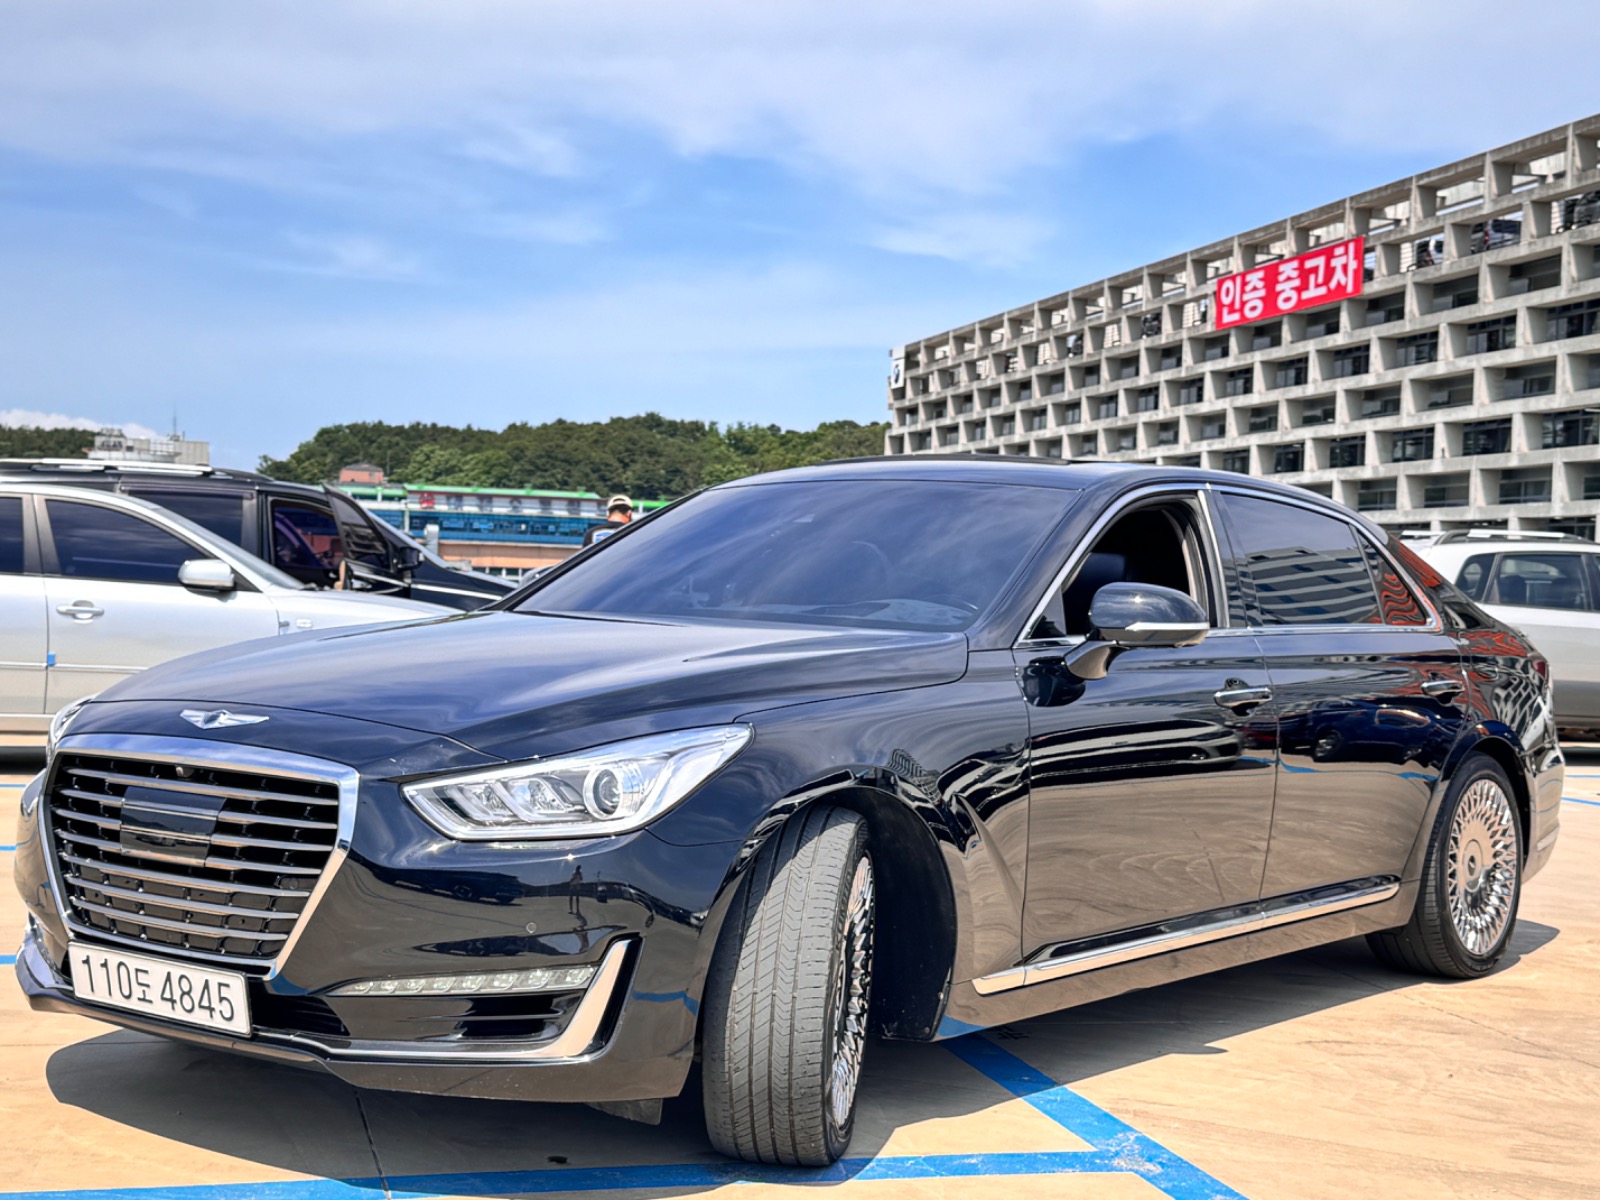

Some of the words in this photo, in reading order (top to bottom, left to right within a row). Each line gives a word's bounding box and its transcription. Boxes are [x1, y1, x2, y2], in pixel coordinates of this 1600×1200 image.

[1220, 271, 1266, 324] 인증
[1275, 242, 1357, 311] 중고차
[81, 955, 153, 1004] 110도
[160, 971, 235, 1022] 4845
